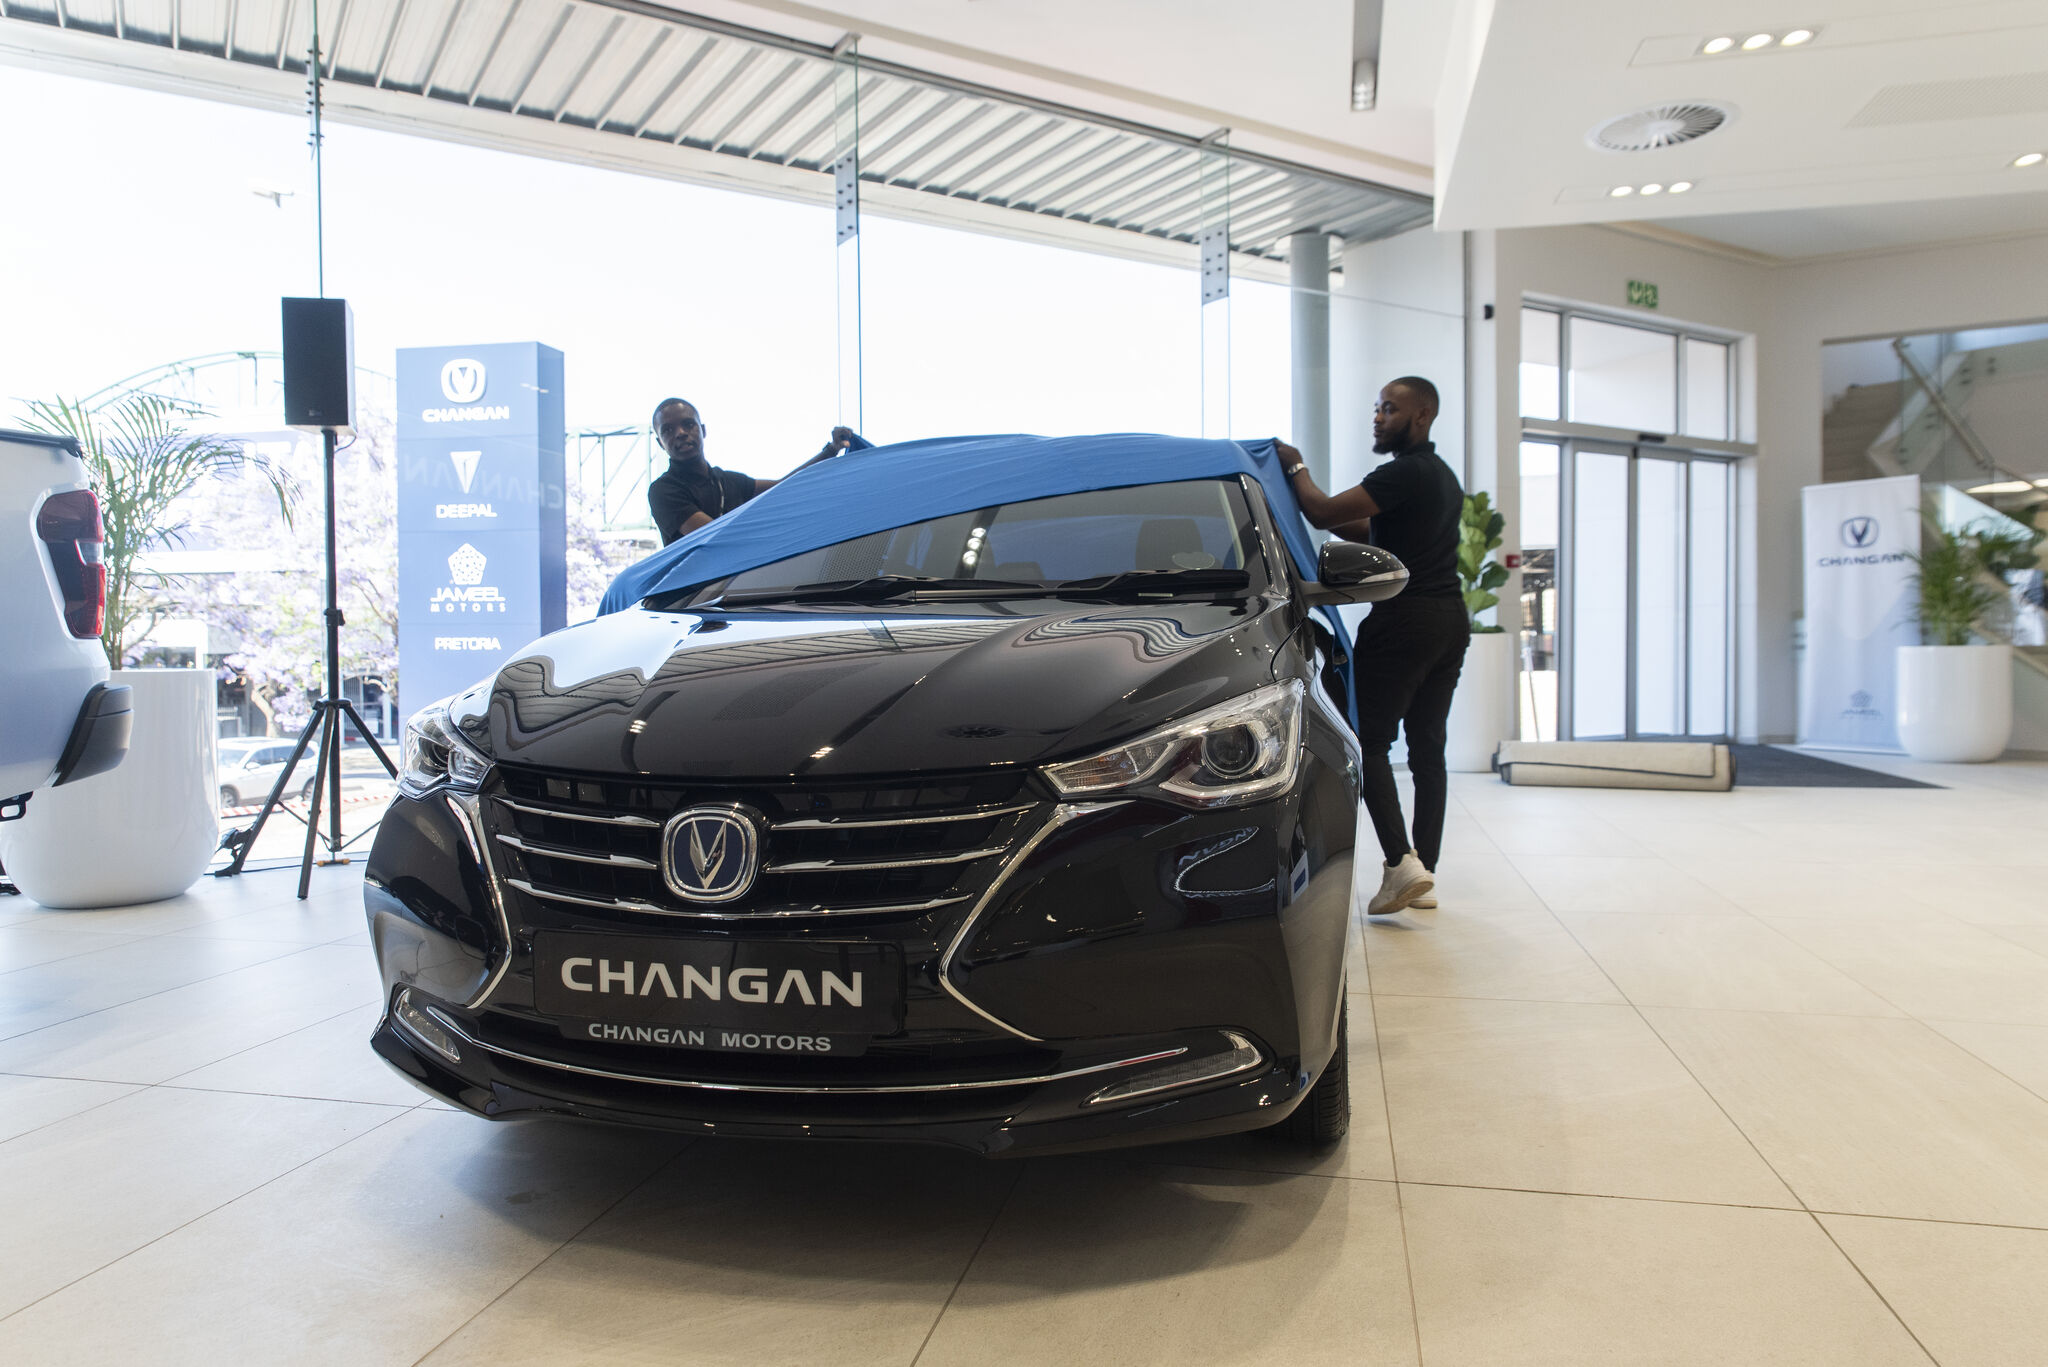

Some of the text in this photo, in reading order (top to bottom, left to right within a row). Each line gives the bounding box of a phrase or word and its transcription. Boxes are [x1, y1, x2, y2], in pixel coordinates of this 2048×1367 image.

[422, 406, 510, 422] CHANGAN
[435, 503, 498, 518] DEEPAL
[1818, 552, 1905, 568] CHANGAN
[430, 586, 506, 602] JAMEEL
[430, 602, 506, 613] MOTORS
[434, 637, 502, 650] PRETORIA
[560, 957, 863, 1007] CHANGAN
[588, 1023, 831, 1052] CHANGAN MOTORS
